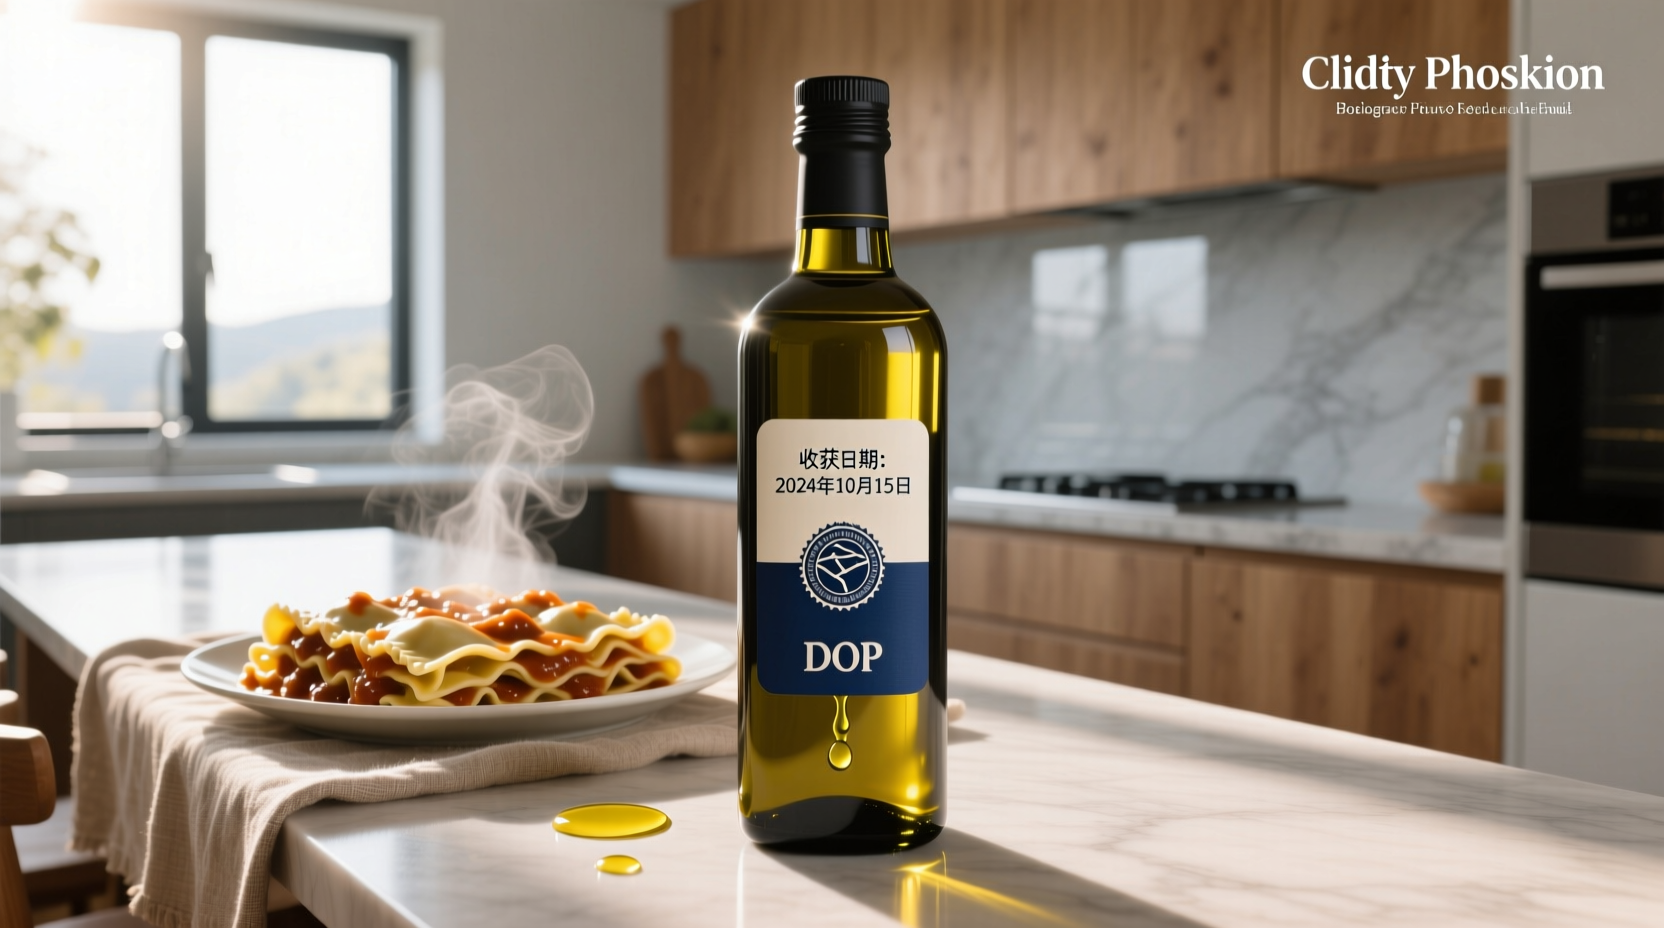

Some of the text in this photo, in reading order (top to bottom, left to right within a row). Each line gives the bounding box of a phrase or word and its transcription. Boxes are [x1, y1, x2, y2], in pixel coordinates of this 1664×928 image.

[775, 476, 911, 496] 2024年10月15日
[803, 641, 883, 673] DOP
